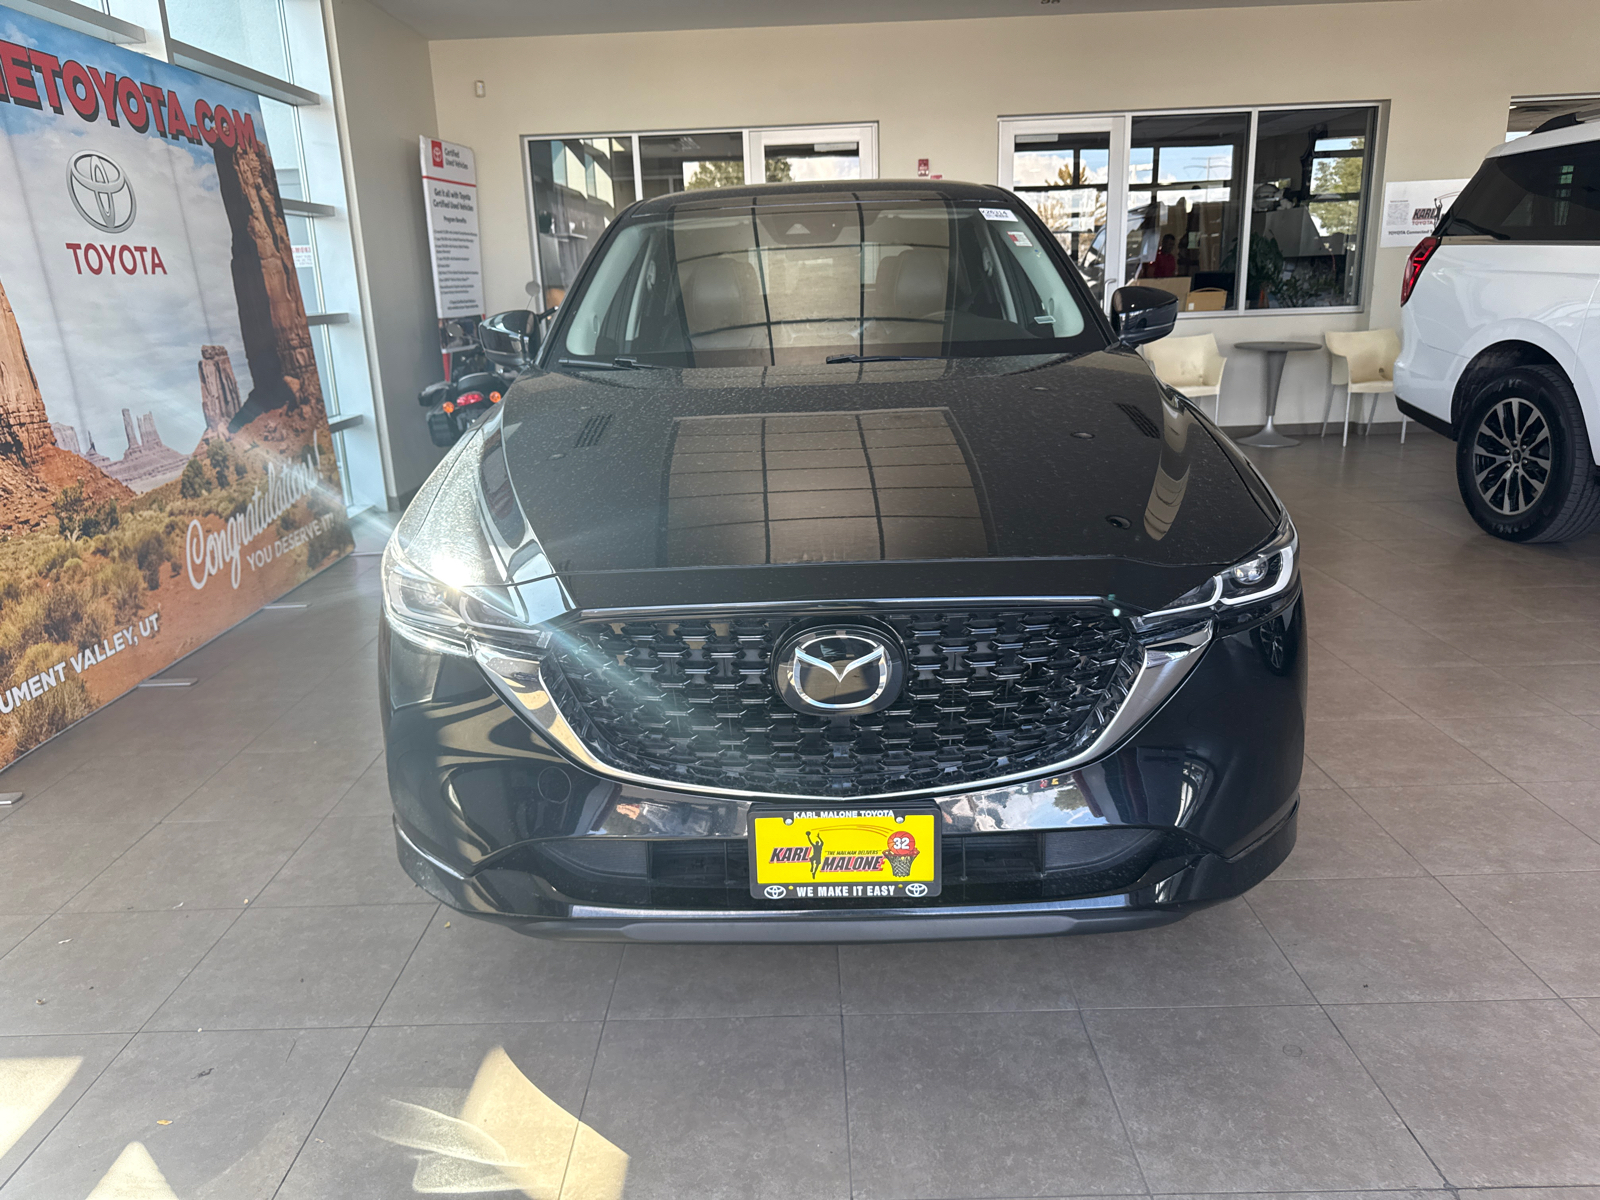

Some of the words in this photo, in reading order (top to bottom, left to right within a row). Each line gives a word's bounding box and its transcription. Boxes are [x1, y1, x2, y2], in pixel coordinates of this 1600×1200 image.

[1412, 208, 1437, 220] KARL
[65, 242, 168, 276] TOYOTA
[186, 429, 324, 590] Congratulations!
[246, 545, 273, 571] YOU
[274, 519, 322, 558] DESERVE
[70, 625, 139, 675] VALLEY,
[139, 613, 159, 637] UT
[793, 811, 819, 819] KARL
[860, 810, 895, 818] TOYOTA
[893, 836, 910, 850] 32
[769, 847, 813, 864] KARL
[820, 856, 886, 872] MALONE
[796, 886, 814, 897] WE
[818, 886, 849, 897] MAKE
[852, 885, 863, 896] IT
[867, 885, 896, 896] EASY
